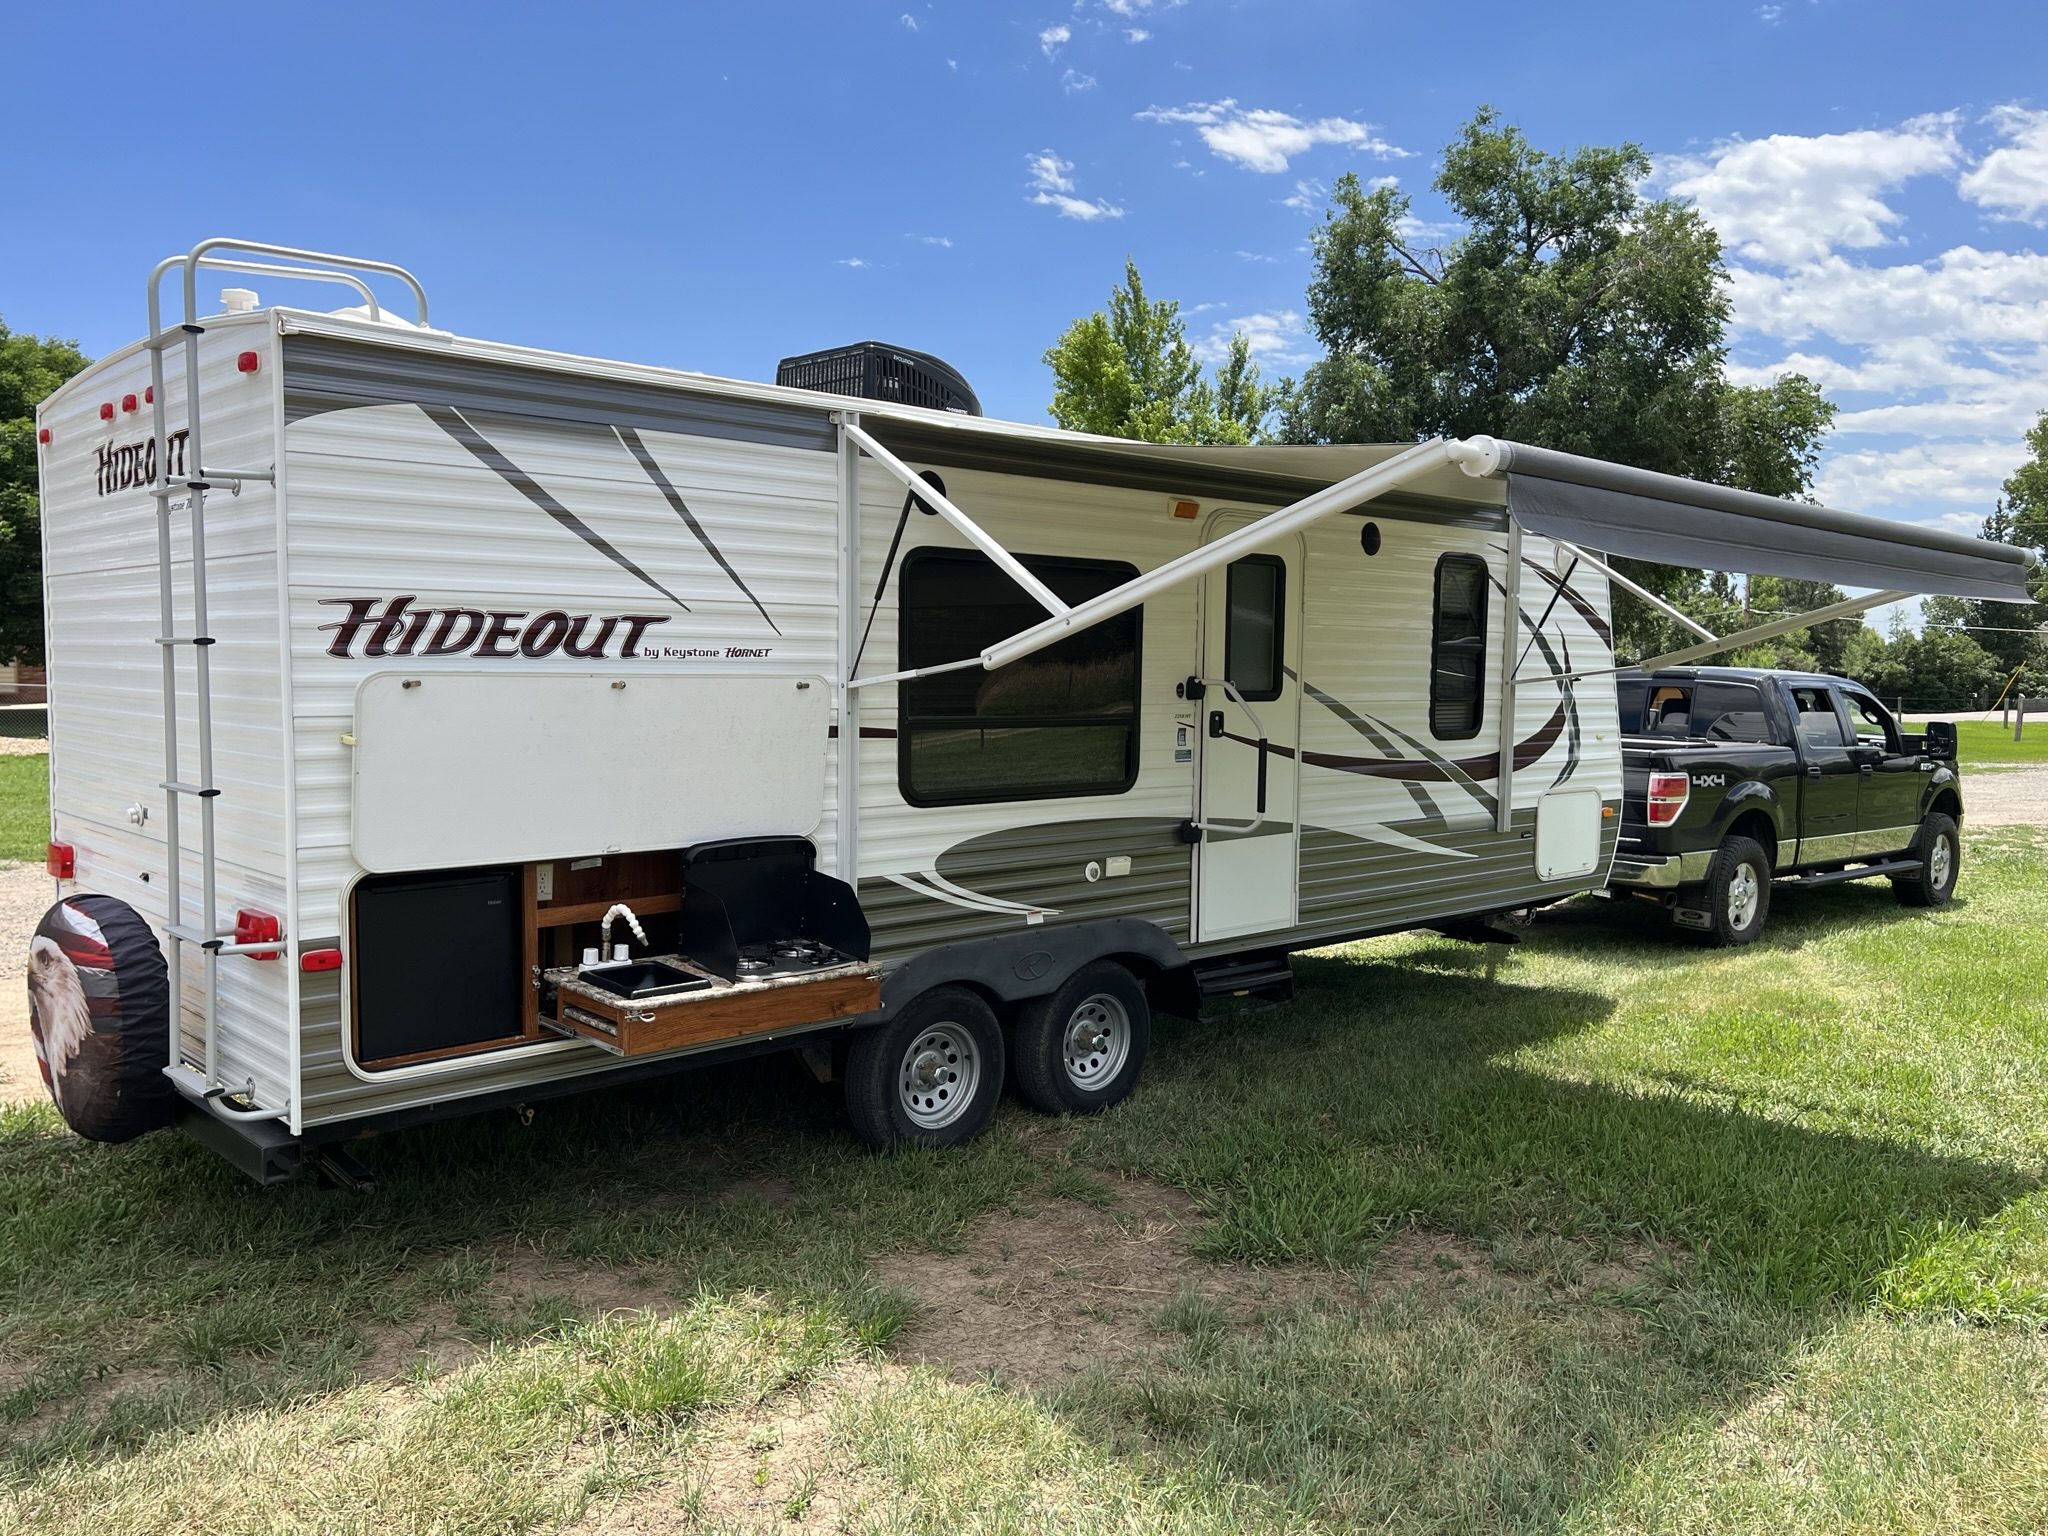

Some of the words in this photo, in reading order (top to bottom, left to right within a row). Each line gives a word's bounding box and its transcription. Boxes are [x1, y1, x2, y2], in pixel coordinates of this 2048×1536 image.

[317, 595, 672, 660] HIDEOUT
[644, 647, 660, 660] by
[663, 647, 720, 660] Keystone
[724, 647, 773, 659] HORNET
